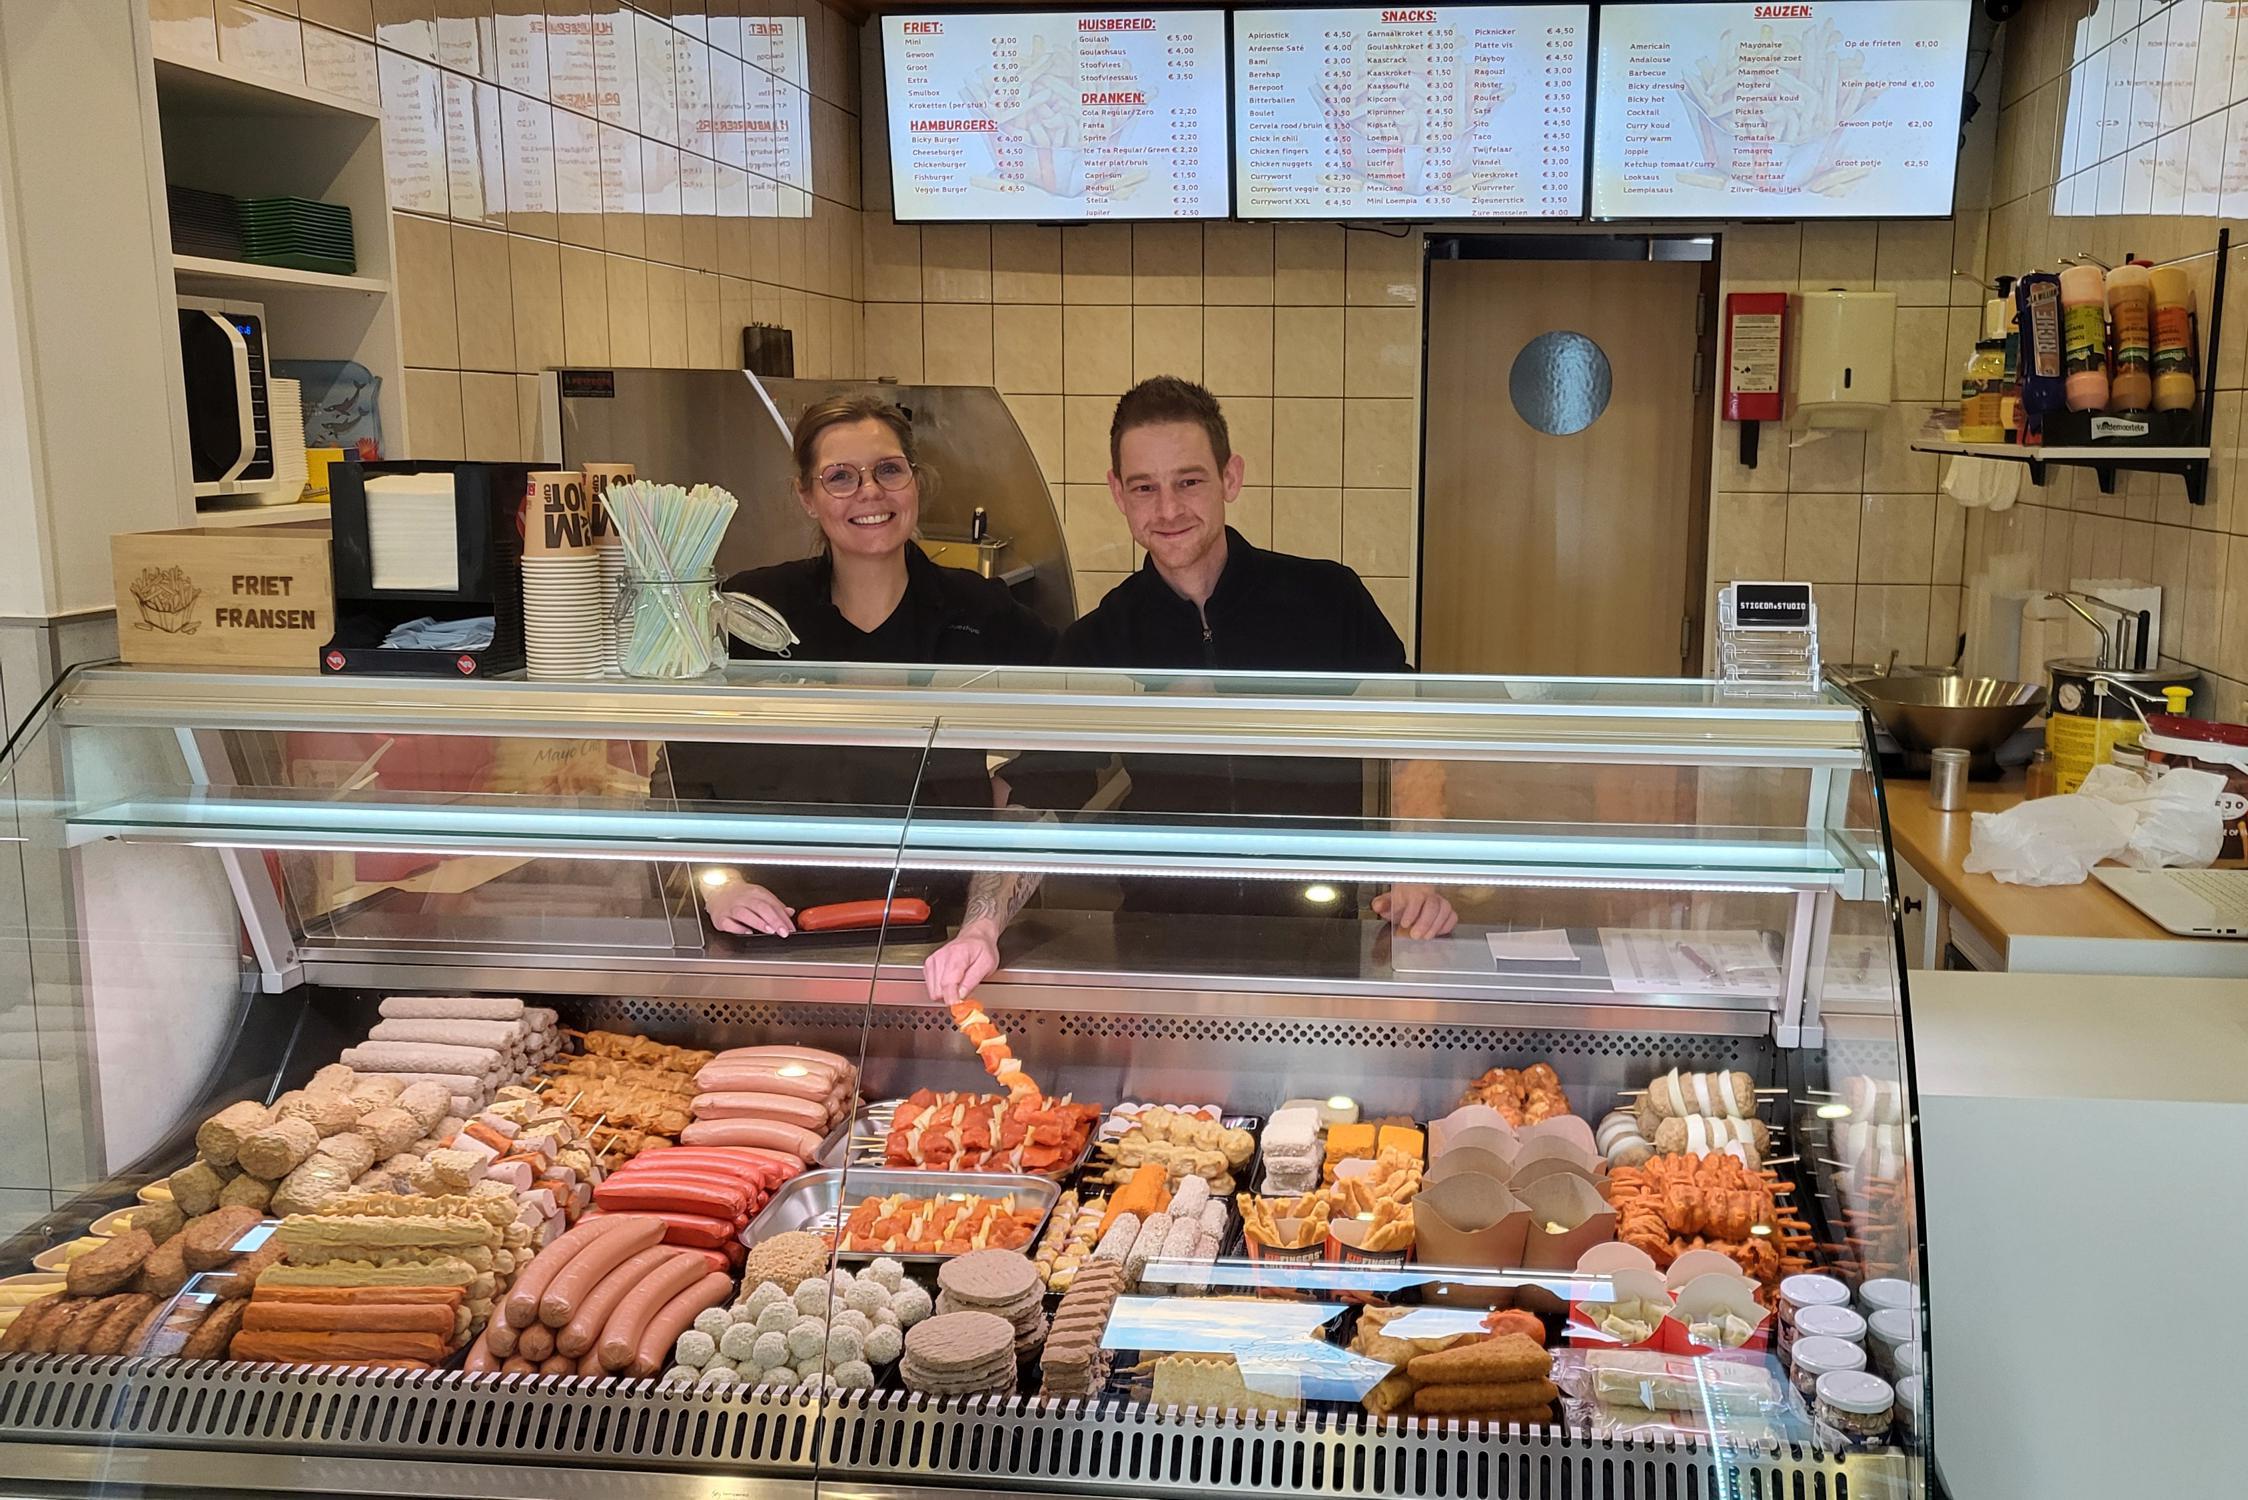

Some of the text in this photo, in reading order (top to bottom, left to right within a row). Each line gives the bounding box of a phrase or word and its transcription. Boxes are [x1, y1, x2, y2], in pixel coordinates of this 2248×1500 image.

[1754, 5, 1813, 17] SAUZEN:
[1381, 10, 1437, 21] SNACKS:
[903, 22, 944, 33] FRIET:
[1078, 18, 1156, 30] HUISBEREID:
[1475, 28, 1516, 36] Picknicker
[1367, 43, 1424, 51] Goulashkroket
[1740, 41, 1782, 50] Mayonaise
[1845, 40, 1857, 48] Op
[1474, 55, 1505, 63] Playboy
[1739, 55, 1781, 63] Mayonaise
[1249, 84, 1284, 92] Berepoot
[1474, 81, 1503, 89] Ribster
[1628, 83, 1685, 91] Bicky dressing
[1841, 80, 1863, 88] Klein
[1081, 93, 1145, 104] DRANKEN:
[1627, 96, 1649, 104] Bicky
[1367, 109, 1405, 117] Kiprunner
[910, 120, 998, 131] HAMBURGERS:
[1626, 122, 1649, 130] Curry
[1838, 120, 1870, 128] Gewoon
[911, 136, 960, 144] Bicky Burger
[1367, 134, 1399, 142] Loempia
[1625, 135, 1648, 143] Curry
[912, 149, 963, 157] Cheeseburger
[1624, 161, 1658, 169] Ketchup
[1860, 160, 1882, 168] potje
[1250, 173, 1292, 181] Curryworst
[915, 186, 968, 194] Veggie Burger
[1251, 198, 1292, 206] Curryworst
[1472, 197, 1525, 205] Zigeunerstick
[231, 575, 293, 597] FRIET
[215, 608, 316, 630] FRANSEN
